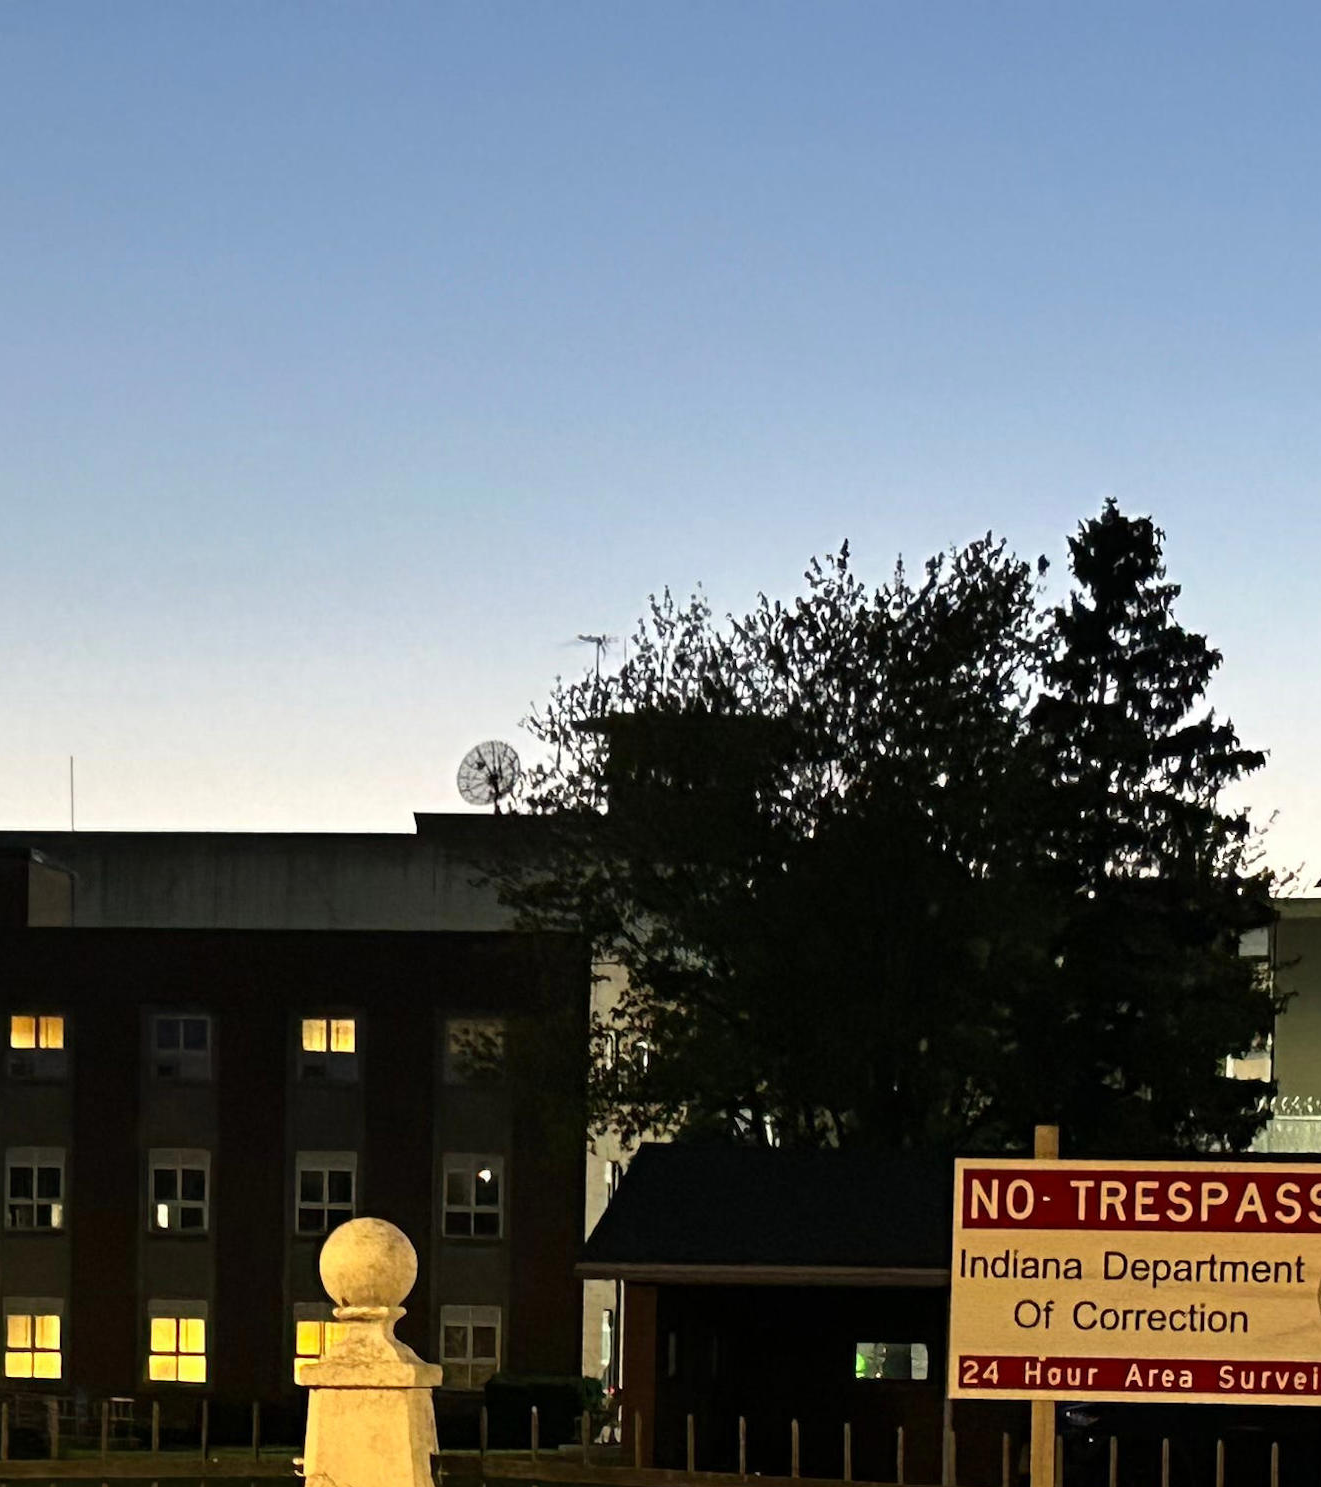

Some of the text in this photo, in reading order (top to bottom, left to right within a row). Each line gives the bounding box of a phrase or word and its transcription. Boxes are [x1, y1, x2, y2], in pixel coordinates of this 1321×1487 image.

[970, 1178, 1034, 1220] NO
[960, 1249, 1305, 1288] Indiana Department
[1014, 1299, 1249, 1333] Of Correction
[962, 1360, 999, 1385] 24
[1025, 1361, 1098, 1386] Hour
[1125, 1364, 1193, 1389] Area
